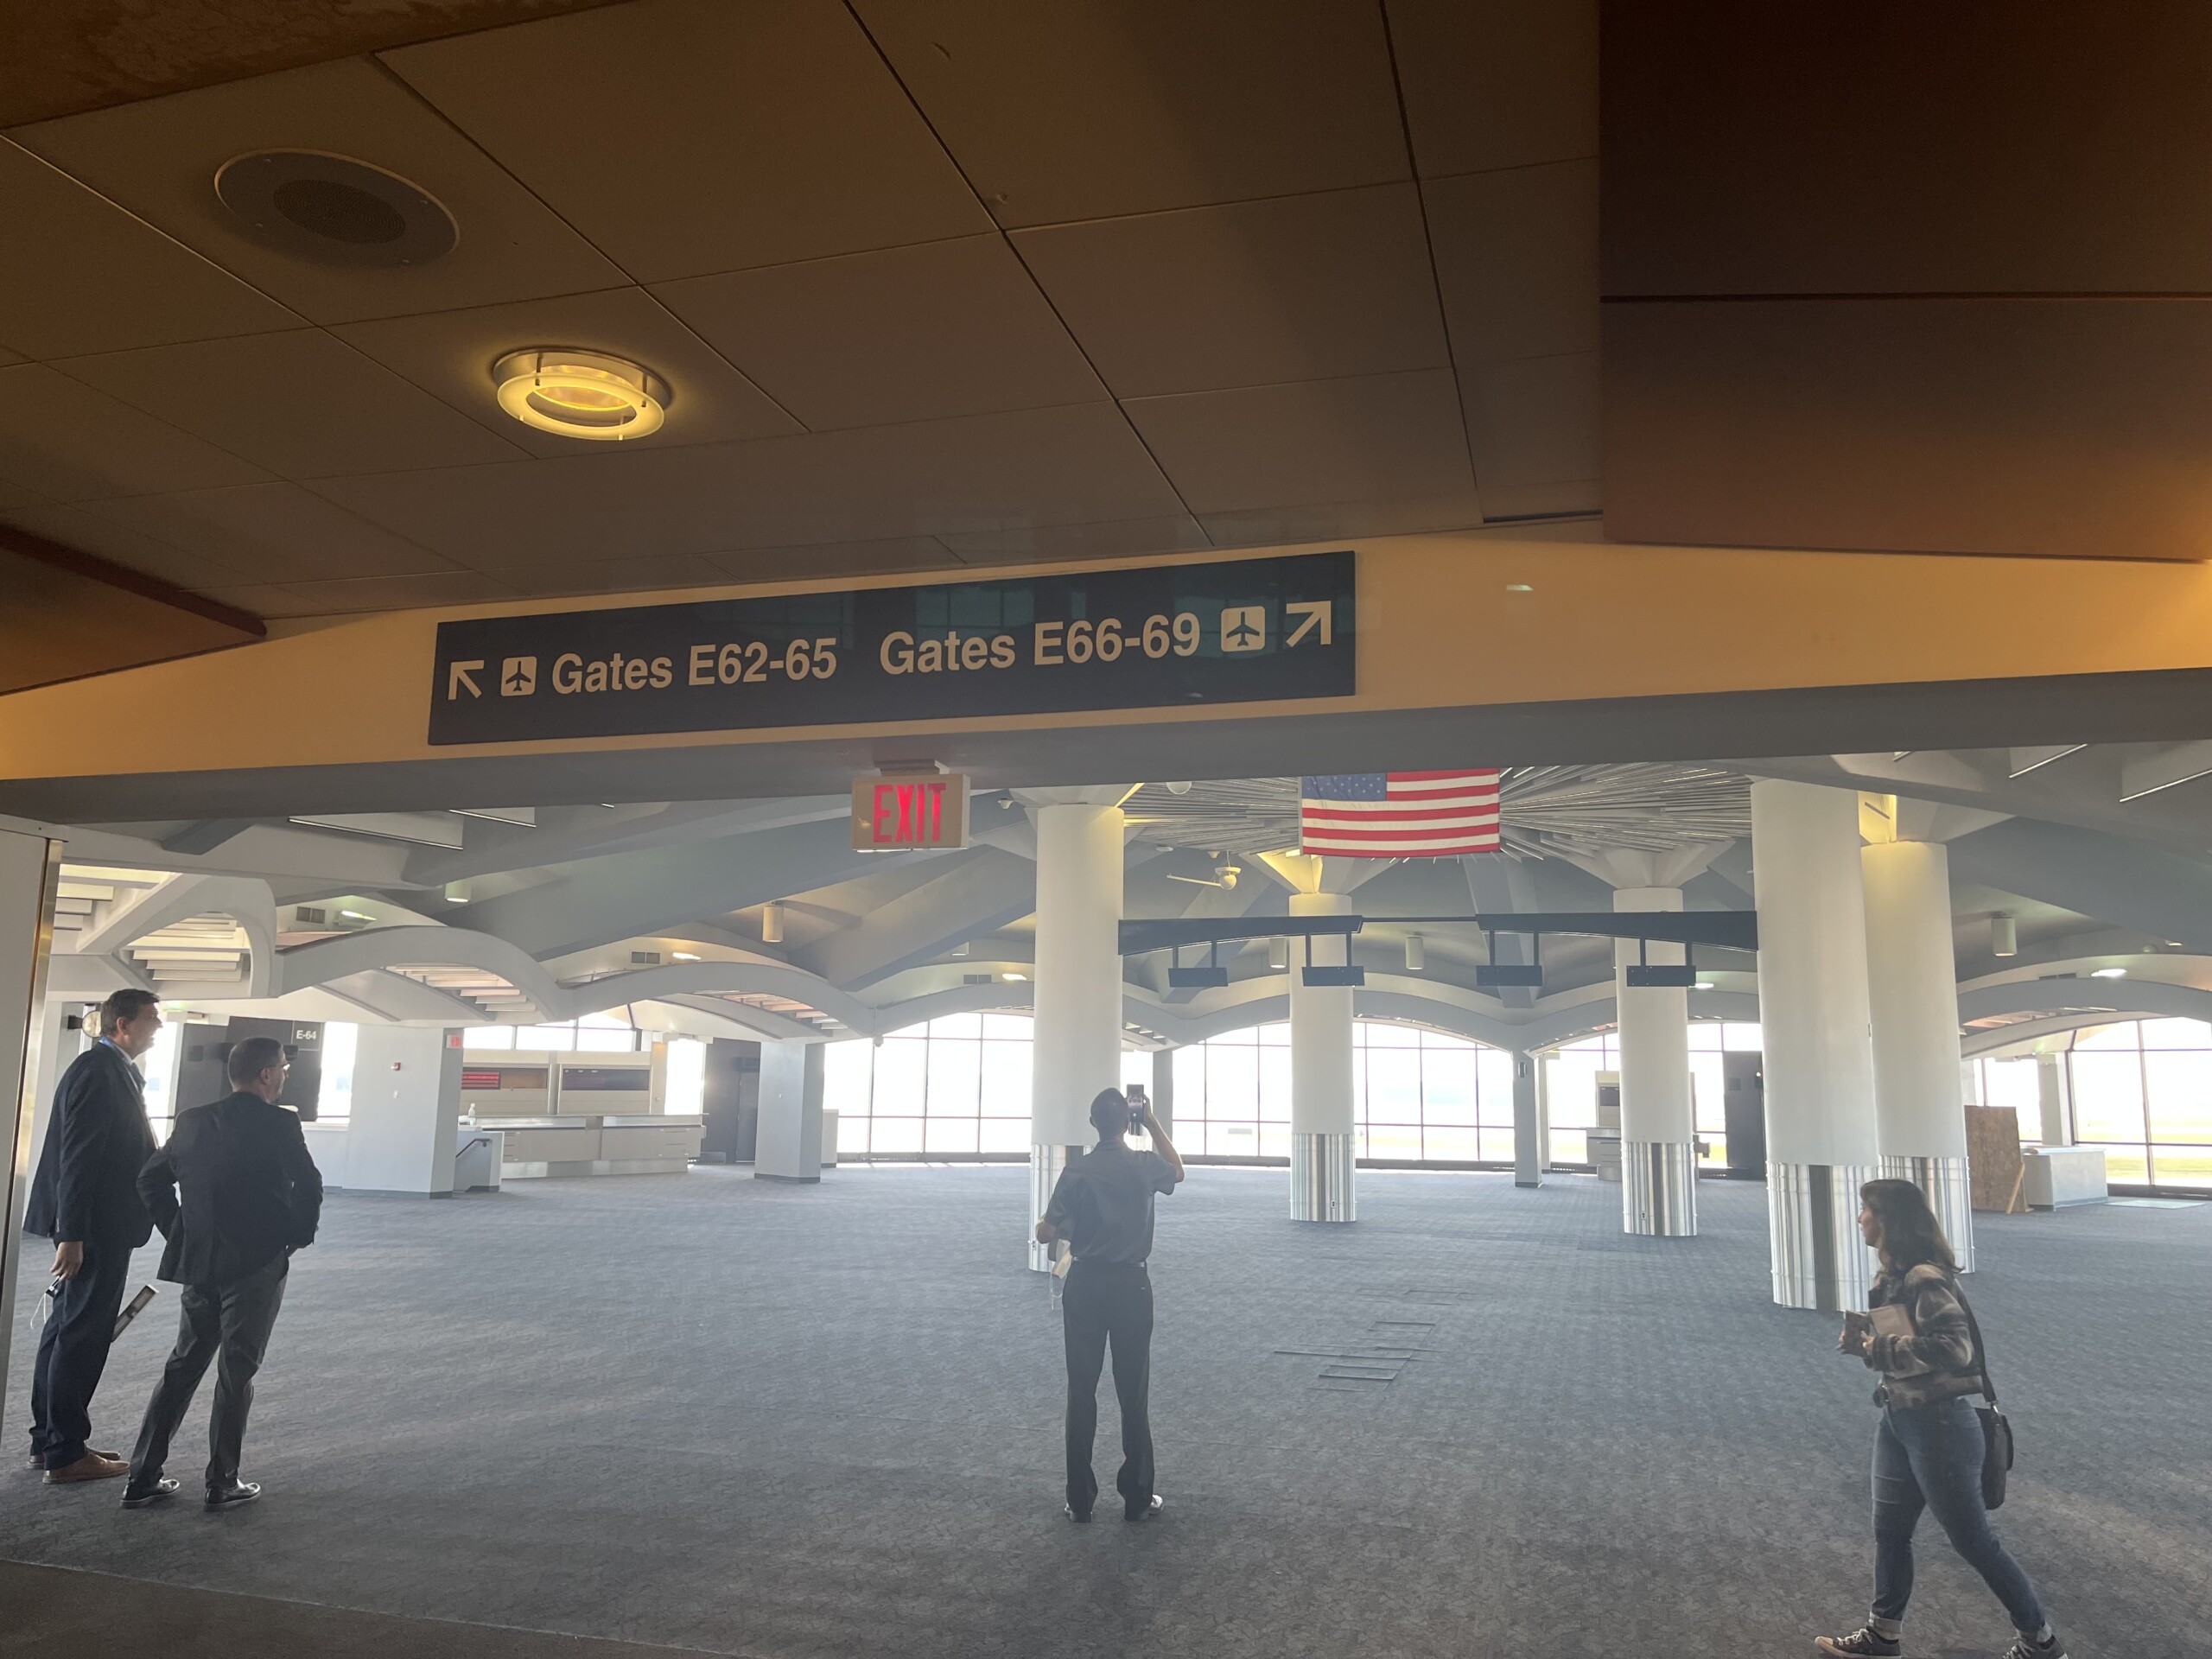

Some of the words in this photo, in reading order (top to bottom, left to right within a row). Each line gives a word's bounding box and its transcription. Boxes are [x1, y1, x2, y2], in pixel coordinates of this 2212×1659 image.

[552, 652, 672, 694] Gates
[689, 638, 836, 686] E62-65
[880, 631, 1015, 675] Gates
[1034, 612, 1200, 665] E66-69
[873, 783, 946, 842] EXIT
[296, 1029, 317, 1039] E-64
